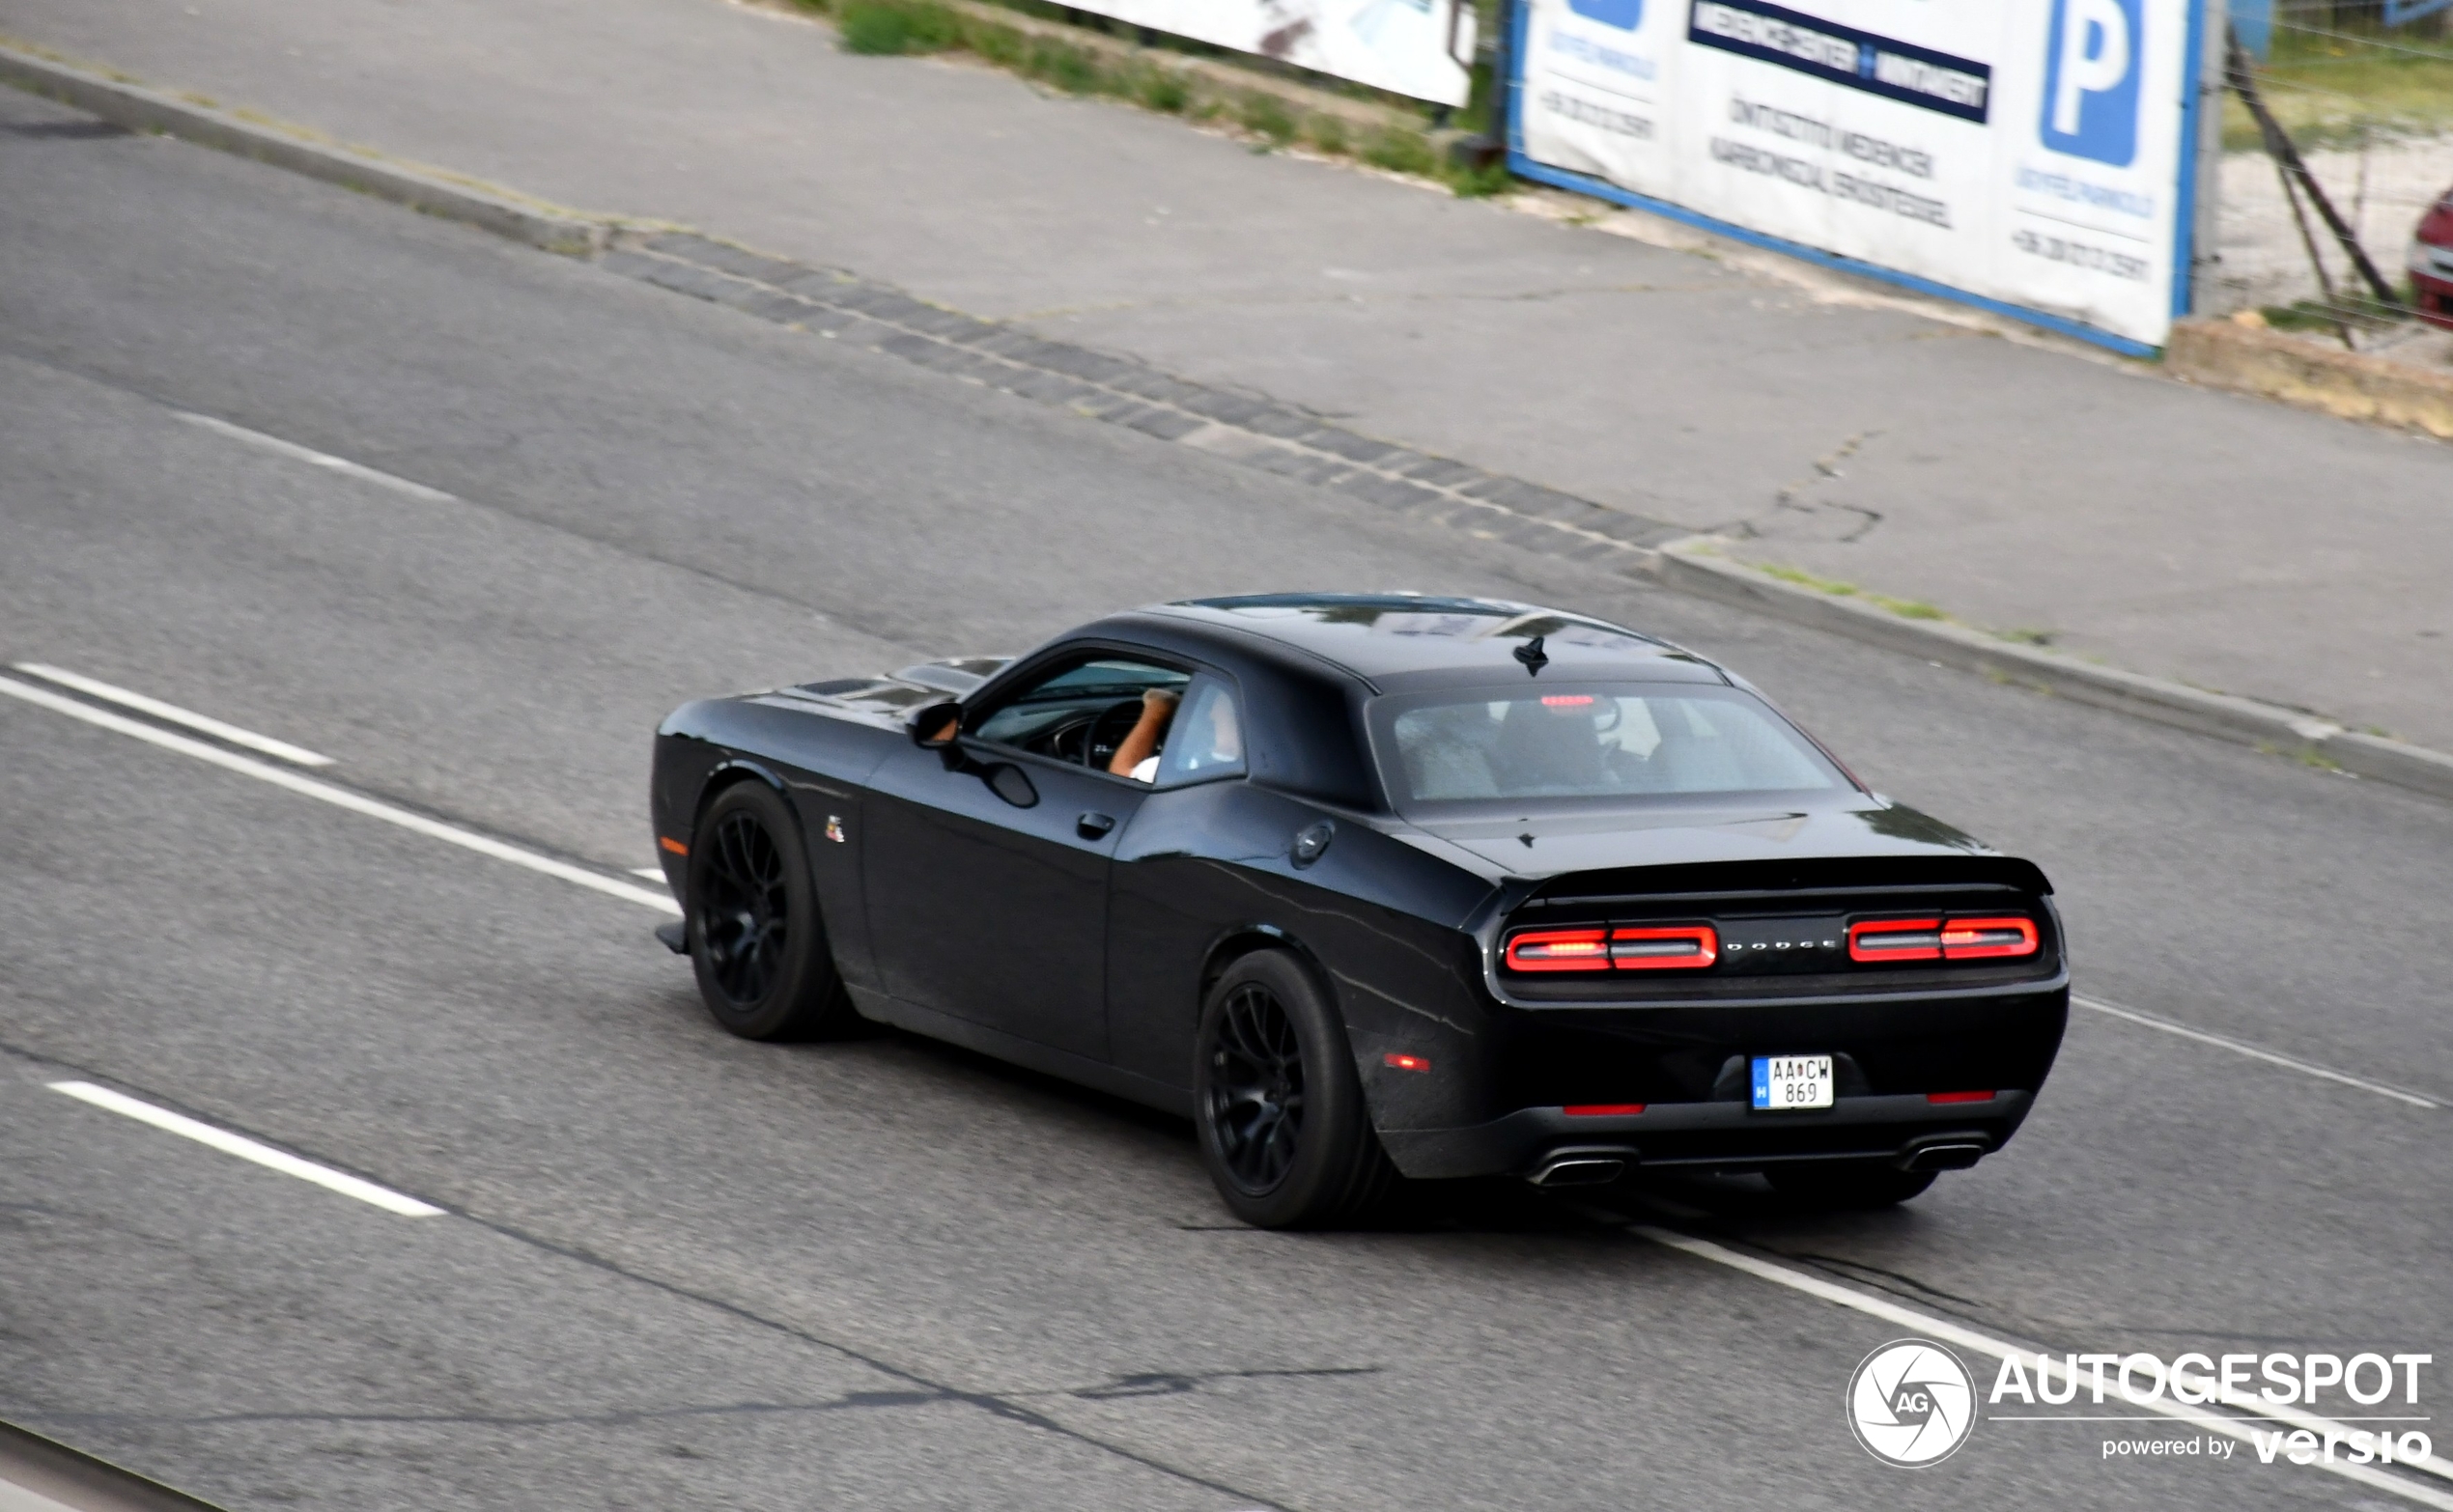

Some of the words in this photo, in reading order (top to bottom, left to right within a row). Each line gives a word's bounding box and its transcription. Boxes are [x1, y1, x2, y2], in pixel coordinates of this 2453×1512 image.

[2052, 0, 2129, 136] P
[1727, 939, 1836, 951] DODGE
[1756, 1086, 1766, 1099] H
[1786, 1082, 1817, 1102] 869
